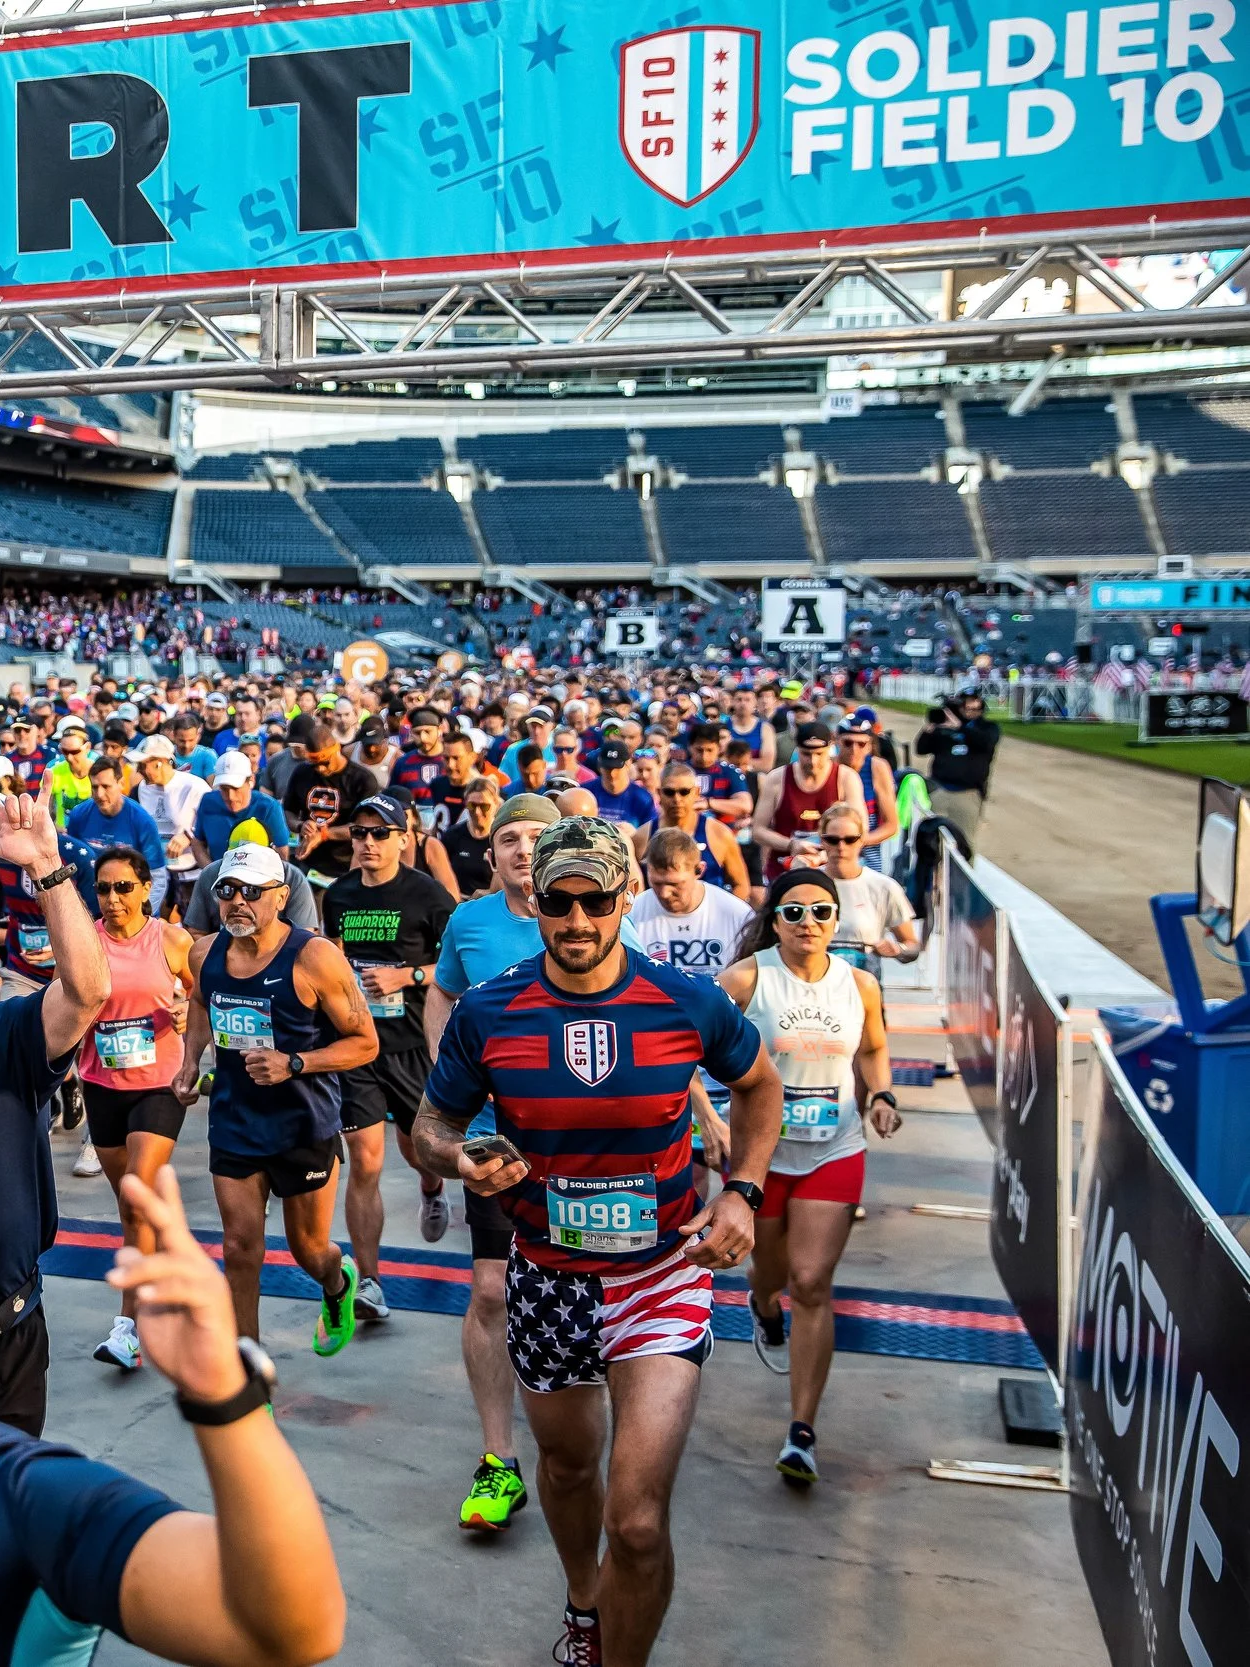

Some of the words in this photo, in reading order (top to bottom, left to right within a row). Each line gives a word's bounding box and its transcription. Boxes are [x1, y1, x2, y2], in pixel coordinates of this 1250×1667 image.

[783, 0, 1236, 105] SOLDIER
[641, 56, 675, 159] SF10
[418, 90, 503, 180] SF
[790, 88, 1076, 177] FIELD
[1110, 71, 1225, 147] 10
[483, 156, 563, 235] 10
[783, 598, 824, 634] A
[619, 623, 644, 645] B
[352, 657, 375, 683] C
[344, 915, 401, 928] SHAMROCK
[216, 1011, 256, 1034] 2166
[778, 1008, 842, 1034] CHICAGO
[102, 1034, 141, 1054] 2167
[219, 1034, 226, 1046] A
[574, 1030, 587, 1066] SF10
[569, 1181, 608, 1189] SOLDIER
[609, 1180, 633, 1189] FIELD
[556, 1201, 631, 1229] 1098
[564, 1229, 578, 1245] B
[583, 1233, 616, 1241] Shane
[1078, 1178, 1240, 1667] MOTIVE
[1104, 1474, 1130, 1551] STOP
